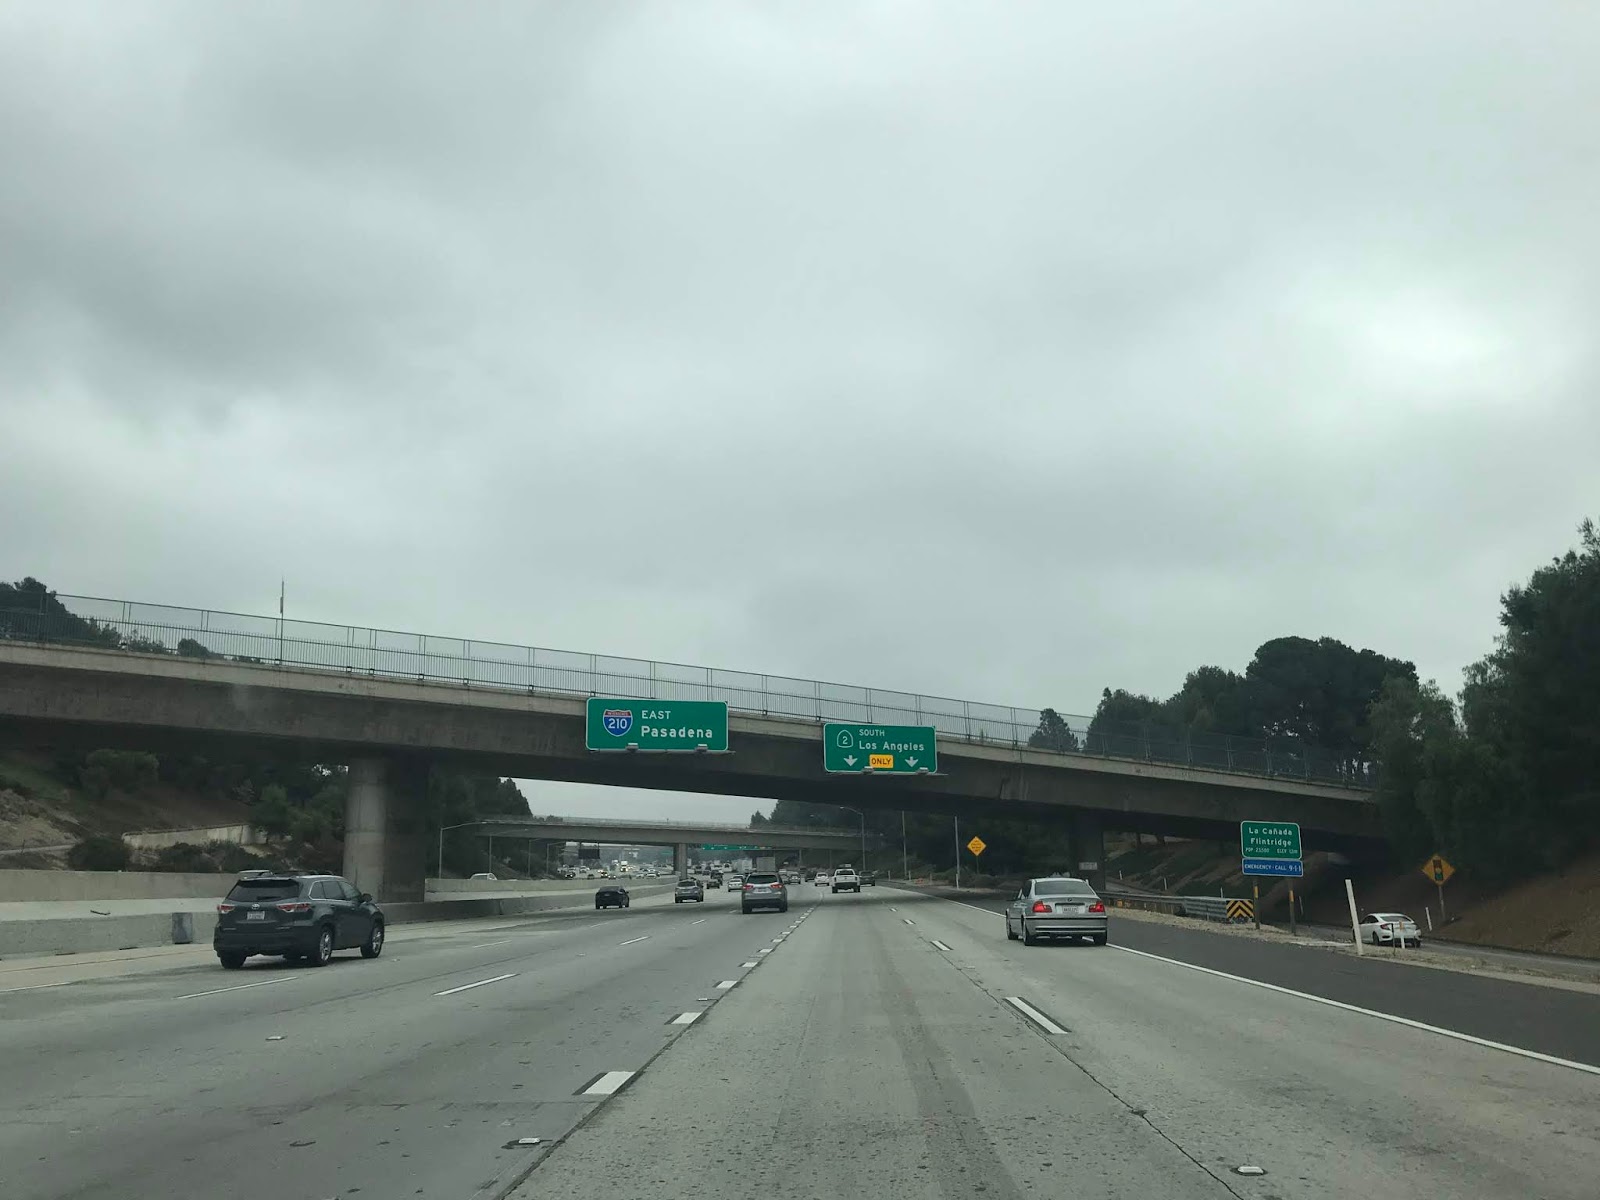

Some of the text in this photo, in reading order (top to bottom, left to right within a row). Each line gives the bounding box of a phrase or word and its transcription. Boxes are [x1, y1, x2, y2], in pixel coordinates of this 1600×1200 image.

[641, 710, 671, 720] EAST
[608, 718, 628, 729] 210
[641, 725, 713, 739] Pasadena
[859, 729, 885, 737] SOUTH
[842, 736, 848, 744] 2
[859, 741, 925, 752] Los Angeles
[871, 757, 892, 765] ONLY
[1250, 838, 1292, 847] Flintridge
